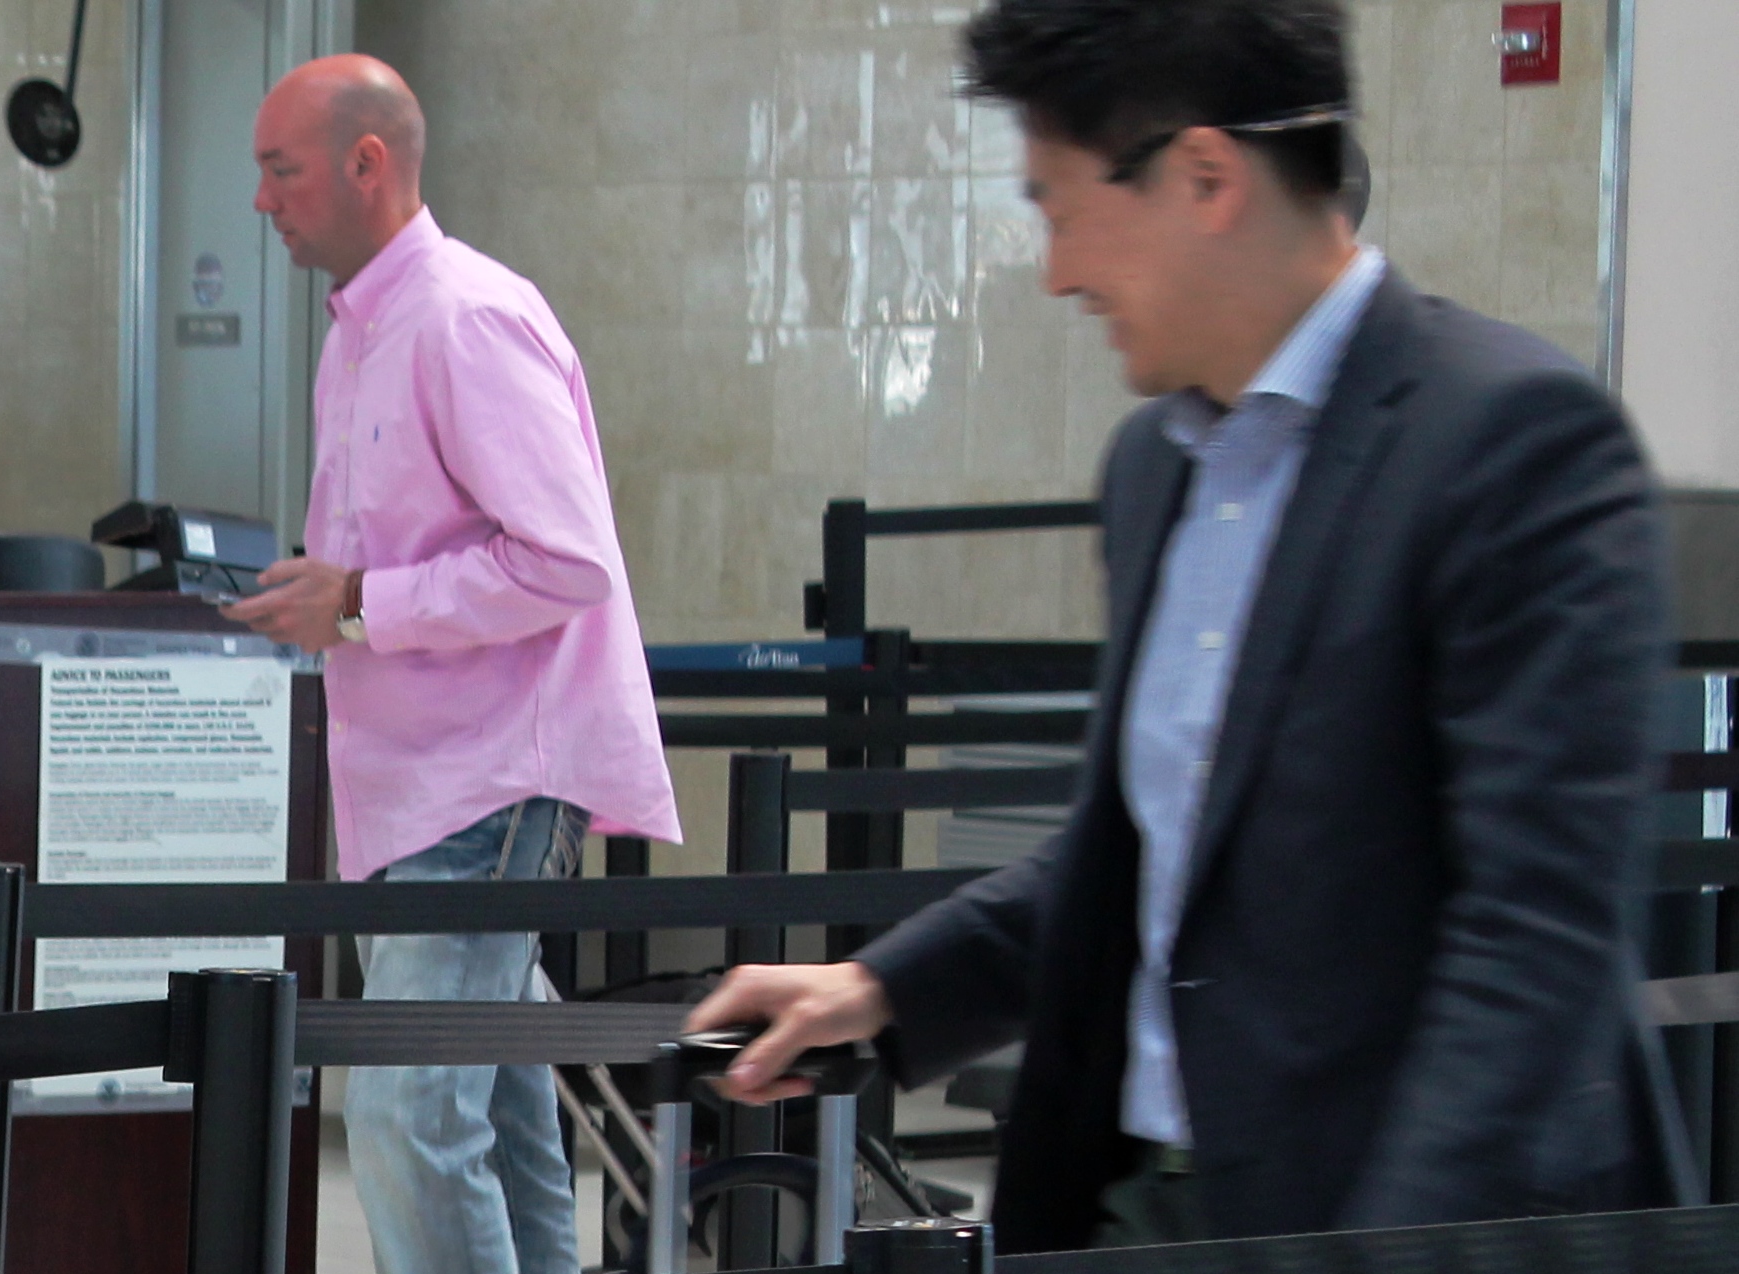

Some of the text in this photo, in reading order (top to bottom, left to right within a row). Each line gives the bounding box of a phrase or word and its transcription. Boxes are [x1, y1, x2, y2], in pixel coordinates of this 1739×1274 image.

[51, 668, 171, 681] ADVICE TO PASSENGERS
